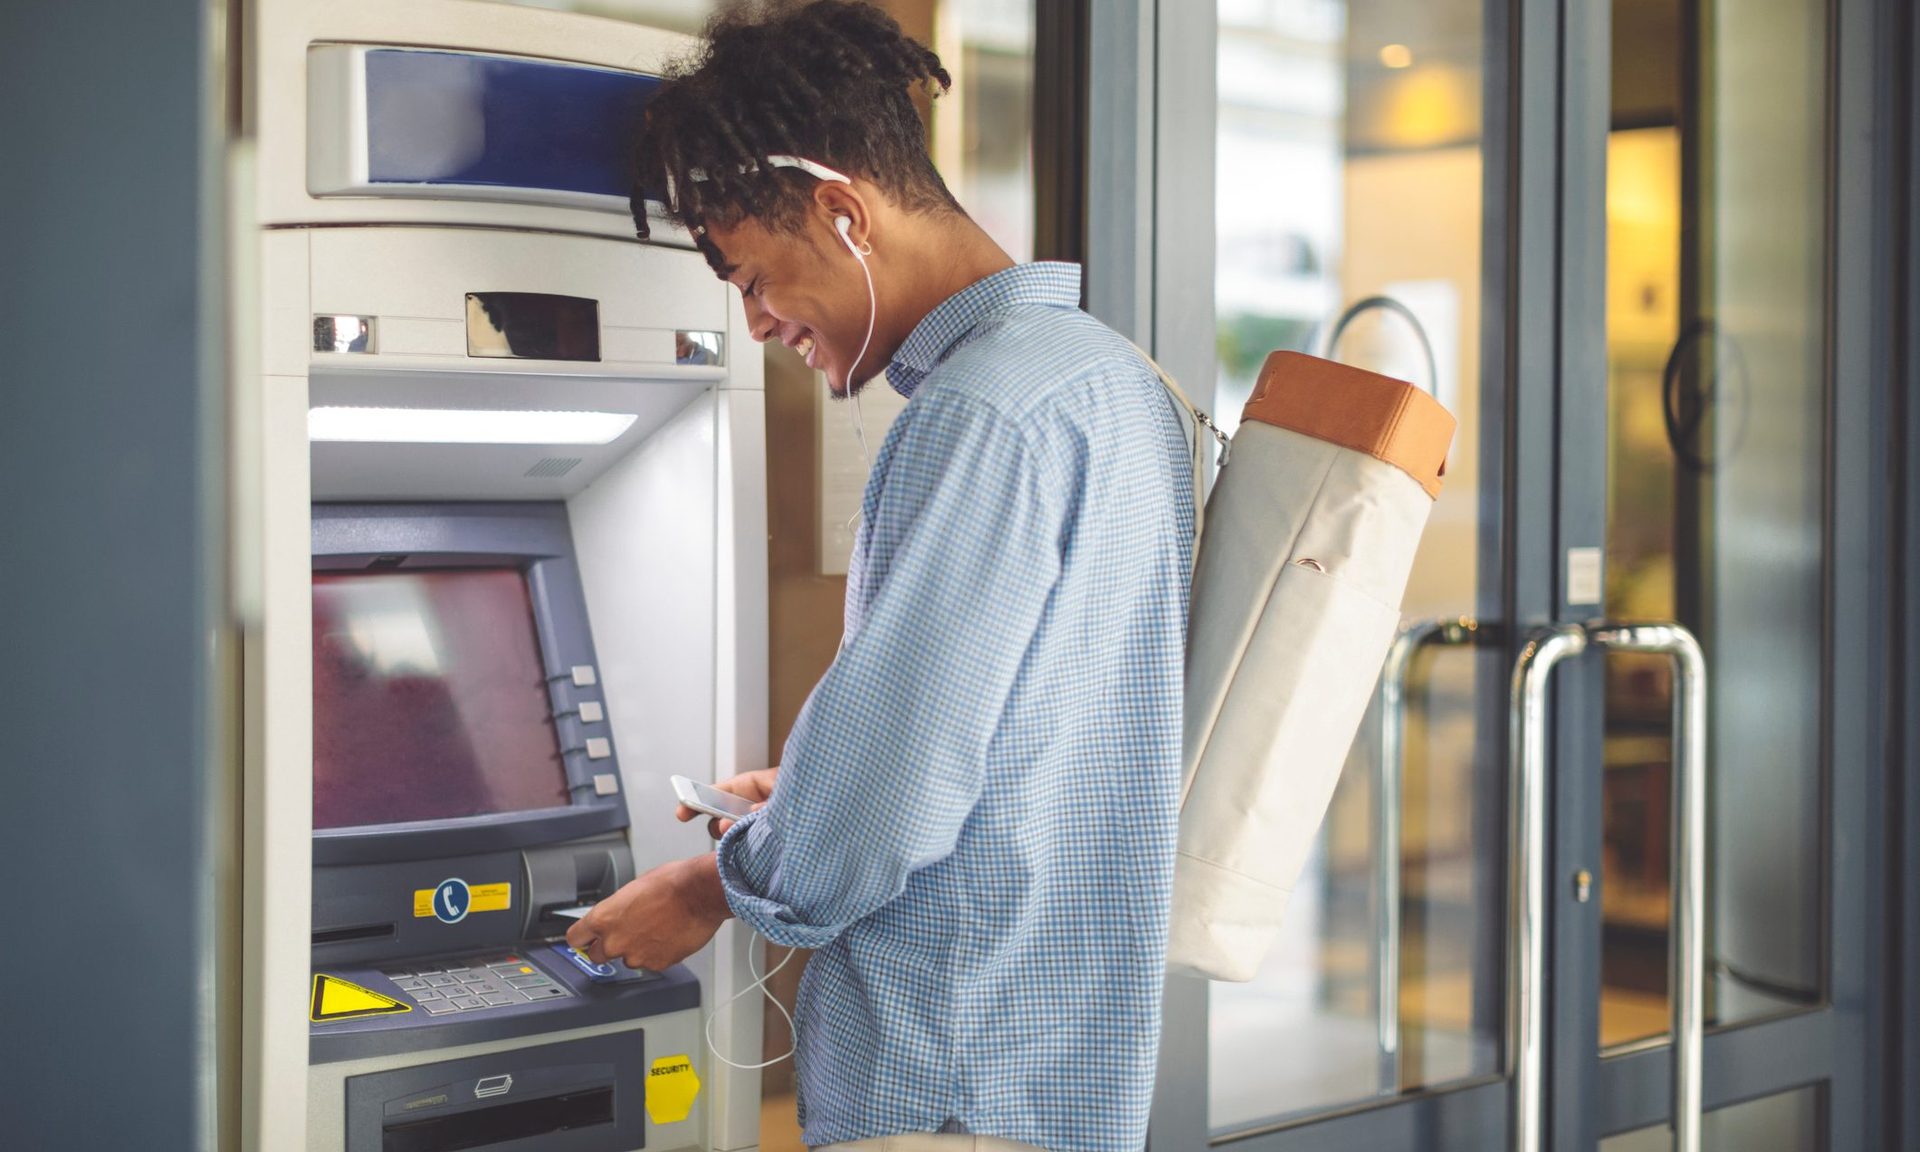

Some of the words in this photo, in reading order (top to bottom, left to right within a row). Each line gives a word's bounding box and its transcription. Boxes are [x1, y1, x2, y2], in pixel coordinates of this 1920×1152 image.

[423, 991, 433, 999] 7
[455, 987, 465, 995] 8
[651, 1064, 689, 1076] SECURITY
